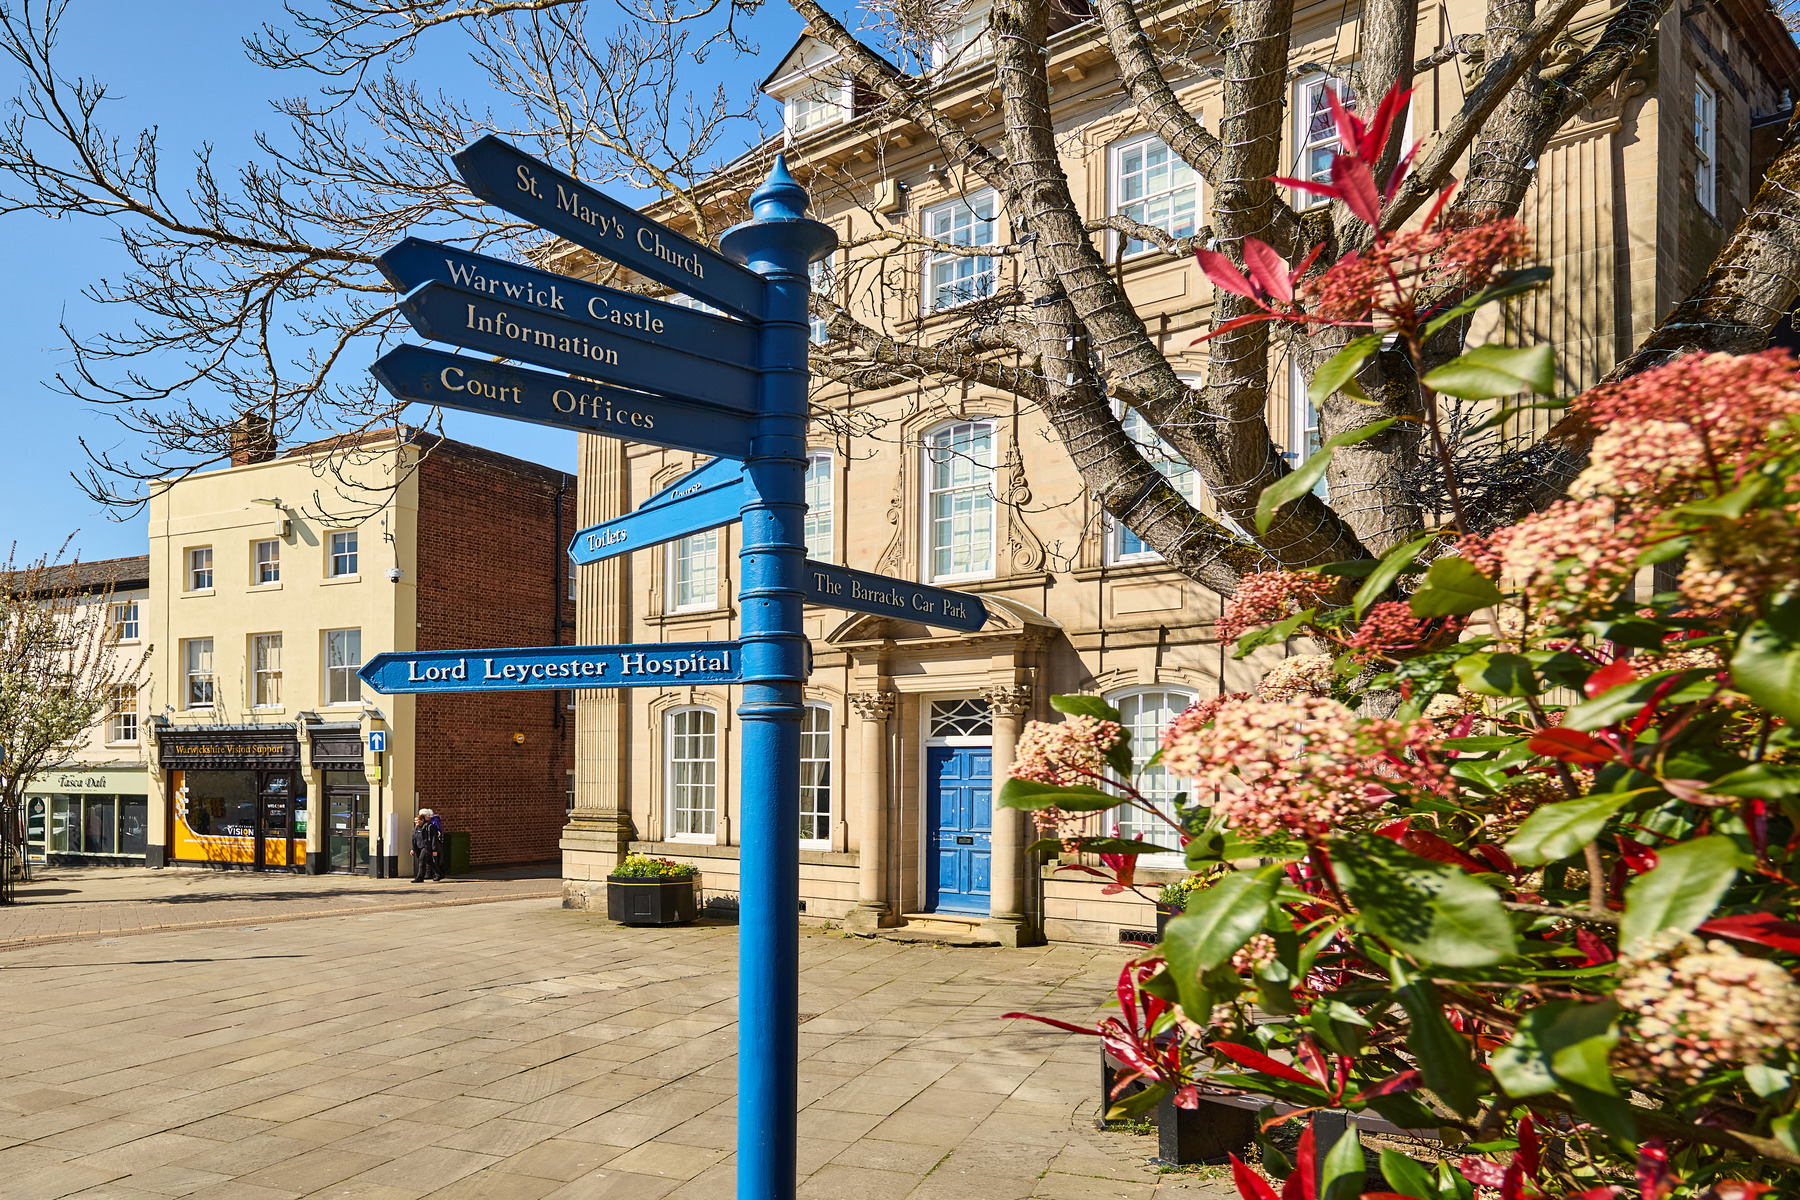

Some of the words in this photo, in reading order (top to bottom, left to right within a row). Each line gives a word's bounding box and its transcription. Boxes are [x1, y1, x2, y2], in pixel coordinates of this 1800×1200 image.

[515, 164, 543, 200] St.
[556, 184, 625, 240] Mary's
[636, 227, 704, 280] Church
[445, 259, 564, 310] Warwick
[587, 297, 664, 334] Castle
[466, 303, 619, 366] Information
[440, 366, 521, 404] Court
[552, 389, 654, 429] Offices
[587, 528, 627, 551] Toilets
[813, 572, 842, 596] The
[851, 580, 905, 608] Barracks
[911, 593, 935, 612] Car
[942, 598, 967, 620] Park
[408, 657, 466, 682] Lord
[484, 657, 606, 682] Leycester
[621, 651, 730, 677] Hospital
[176, 745, 225, 754] Warwickshire
[227, 745, 251, 753] Vision
[252, 744, 284, 755] Support
[58, 776, 83, 788] Tasca
[227, 827, 255, 837] VISION
